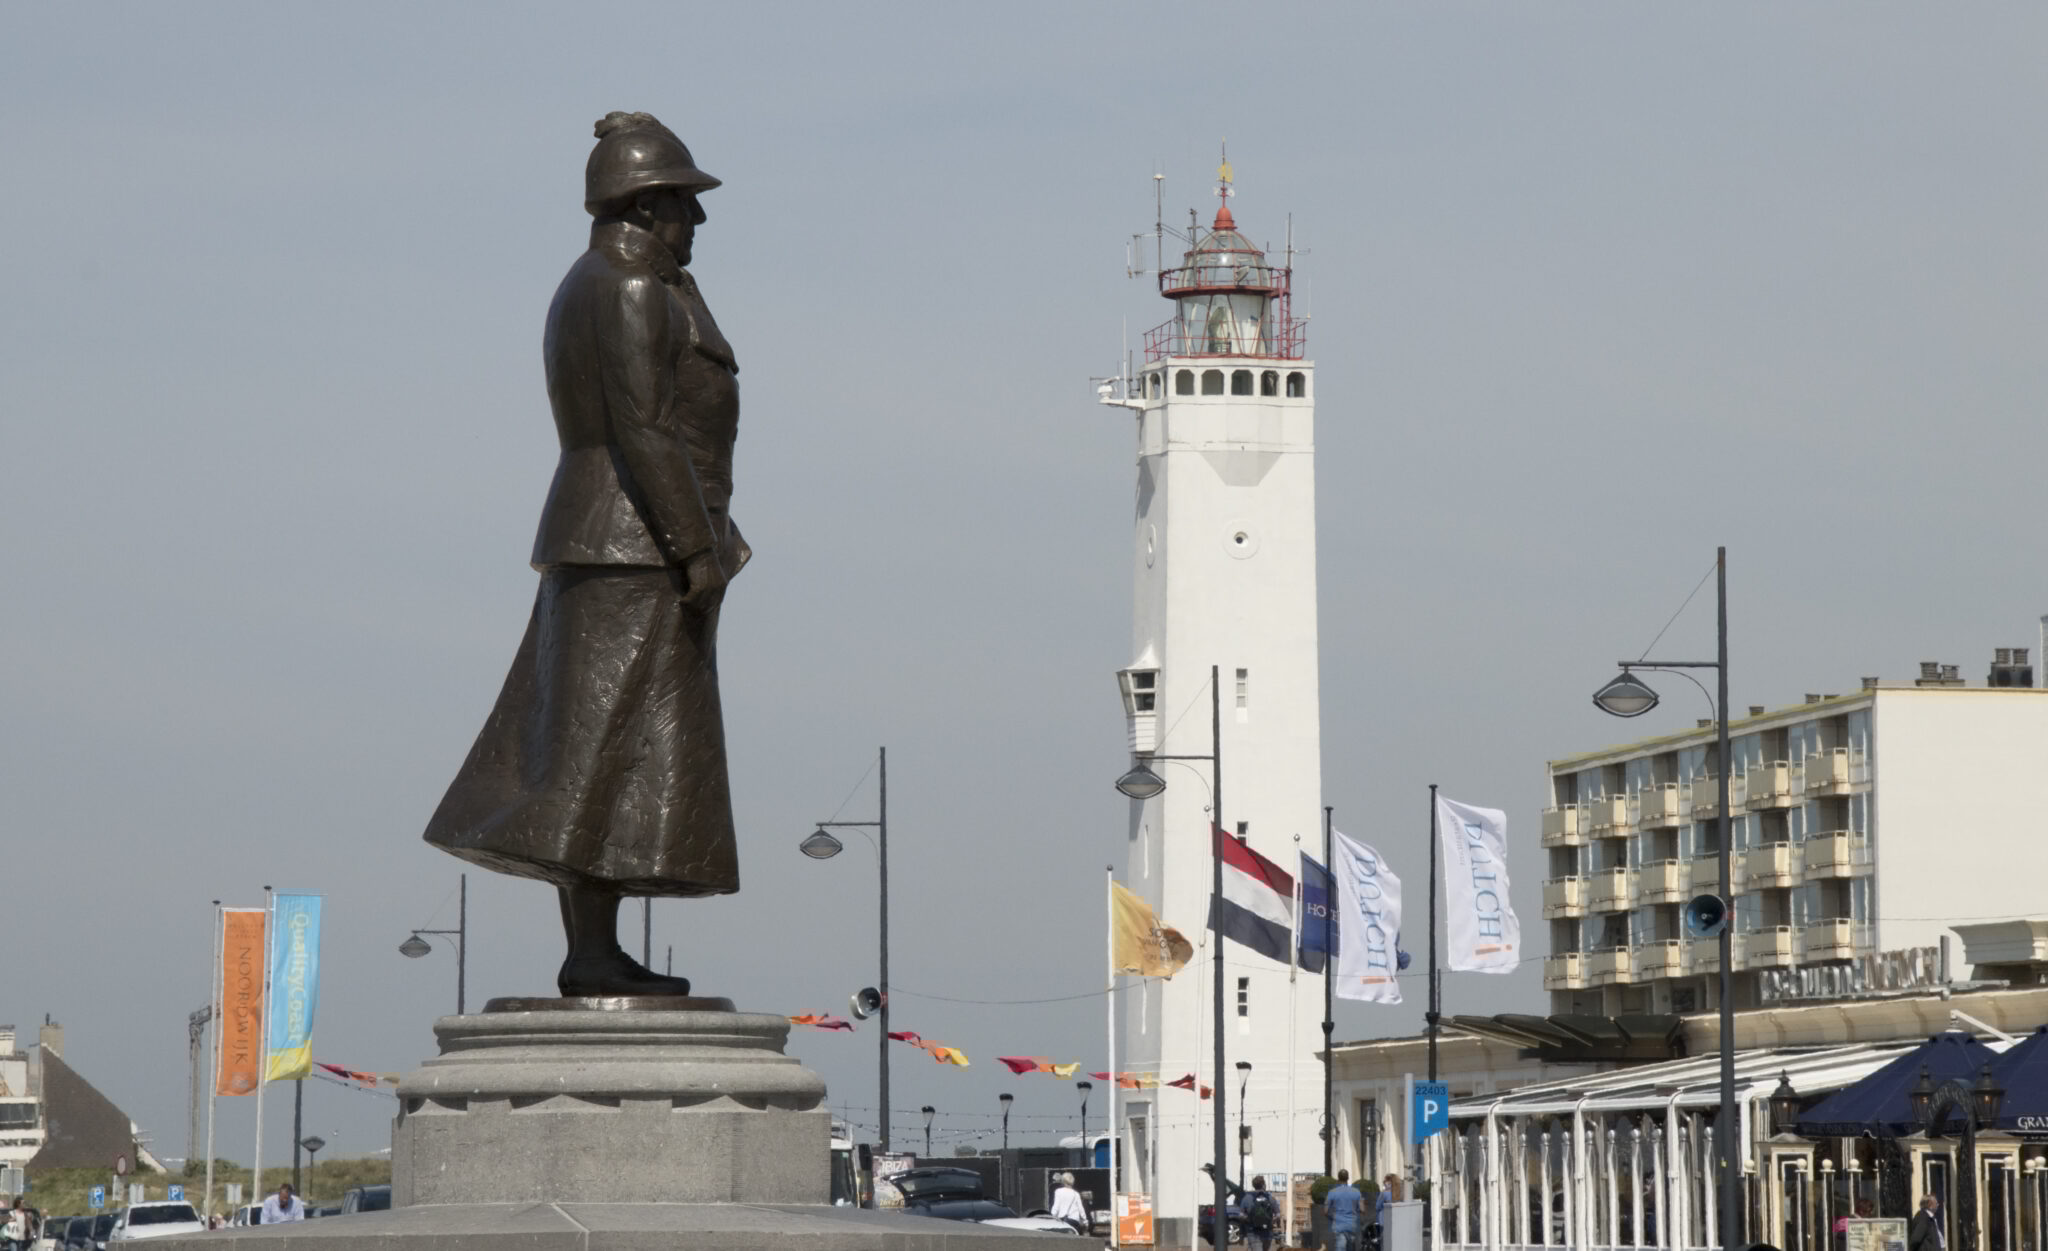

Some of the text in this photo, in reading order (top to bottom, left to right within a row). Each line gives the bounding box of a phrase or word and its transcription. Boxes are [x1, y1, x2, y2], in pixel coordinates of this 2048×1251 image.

[232, 947, 252, 1064] NOORDWIJK
[288, 914, 309, 1042] QualityCoast
[1416, 1086, 1446, 1096] 22403
[1424, 1100, 1438, 1123] P
